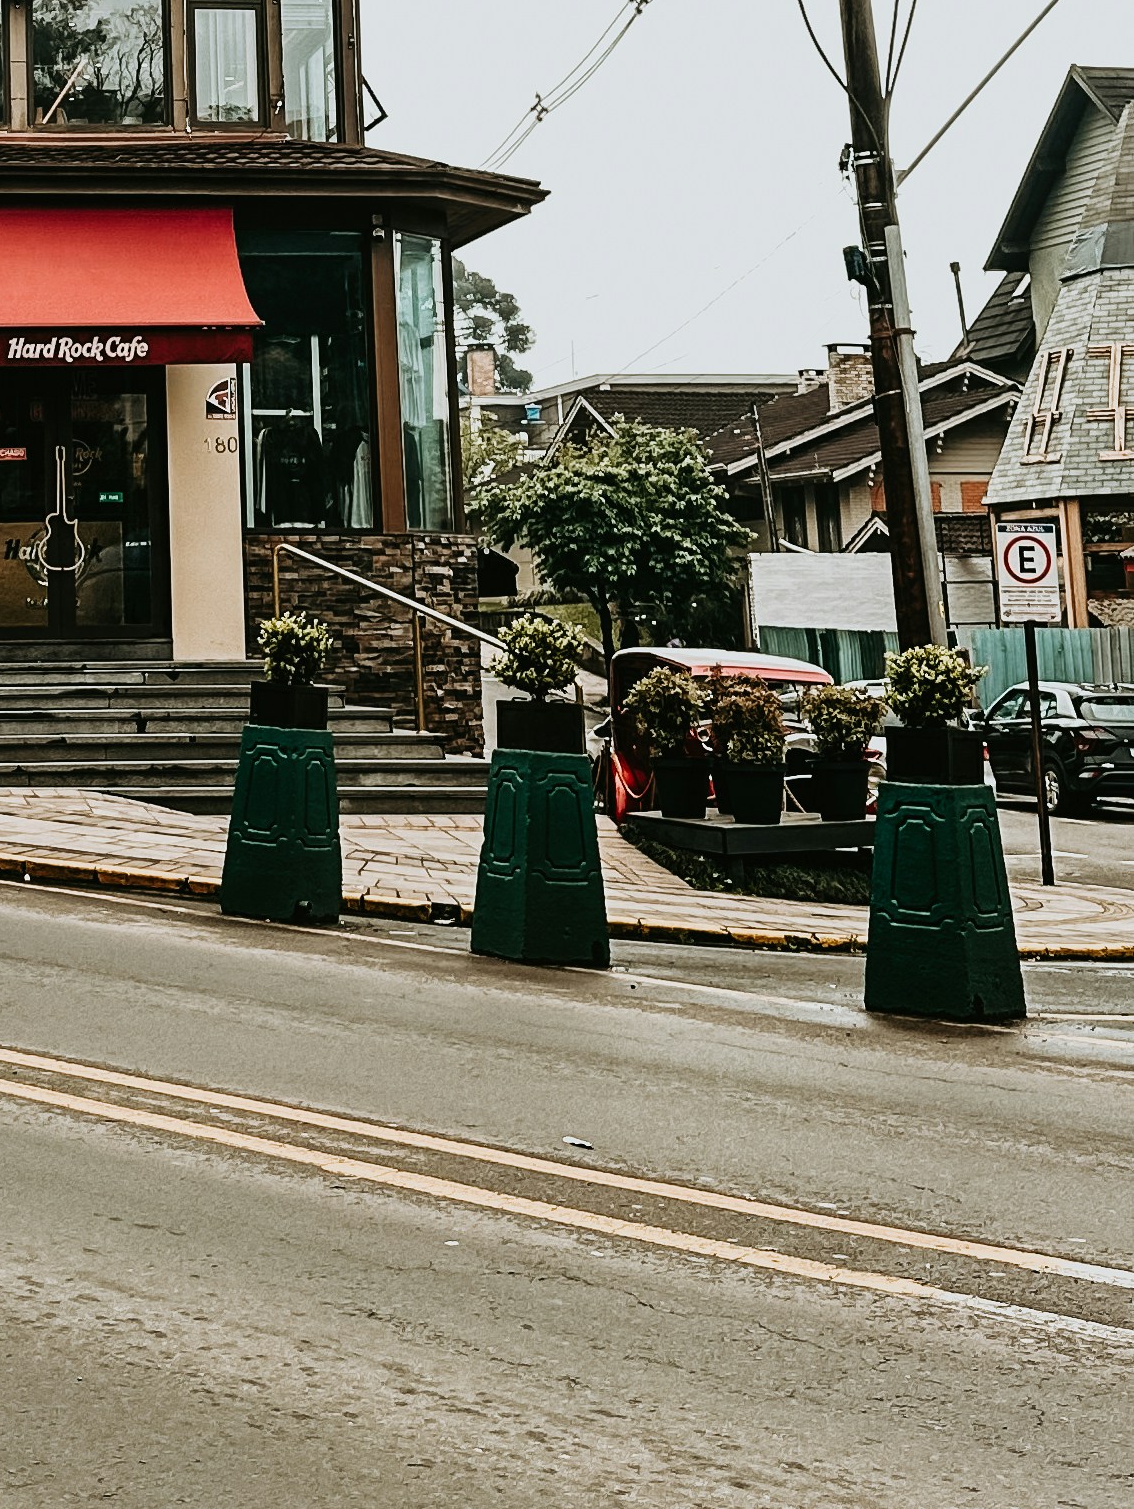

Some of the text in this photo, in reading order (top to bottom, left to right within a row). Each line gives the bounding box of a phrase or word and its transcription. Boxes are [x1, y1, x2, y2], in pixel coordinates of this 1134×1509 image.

[8, 336, 149, 363] Hard Rock Cafe
[204, 436, 238, 454] 180
[1018, 545, 1036, 573] E
